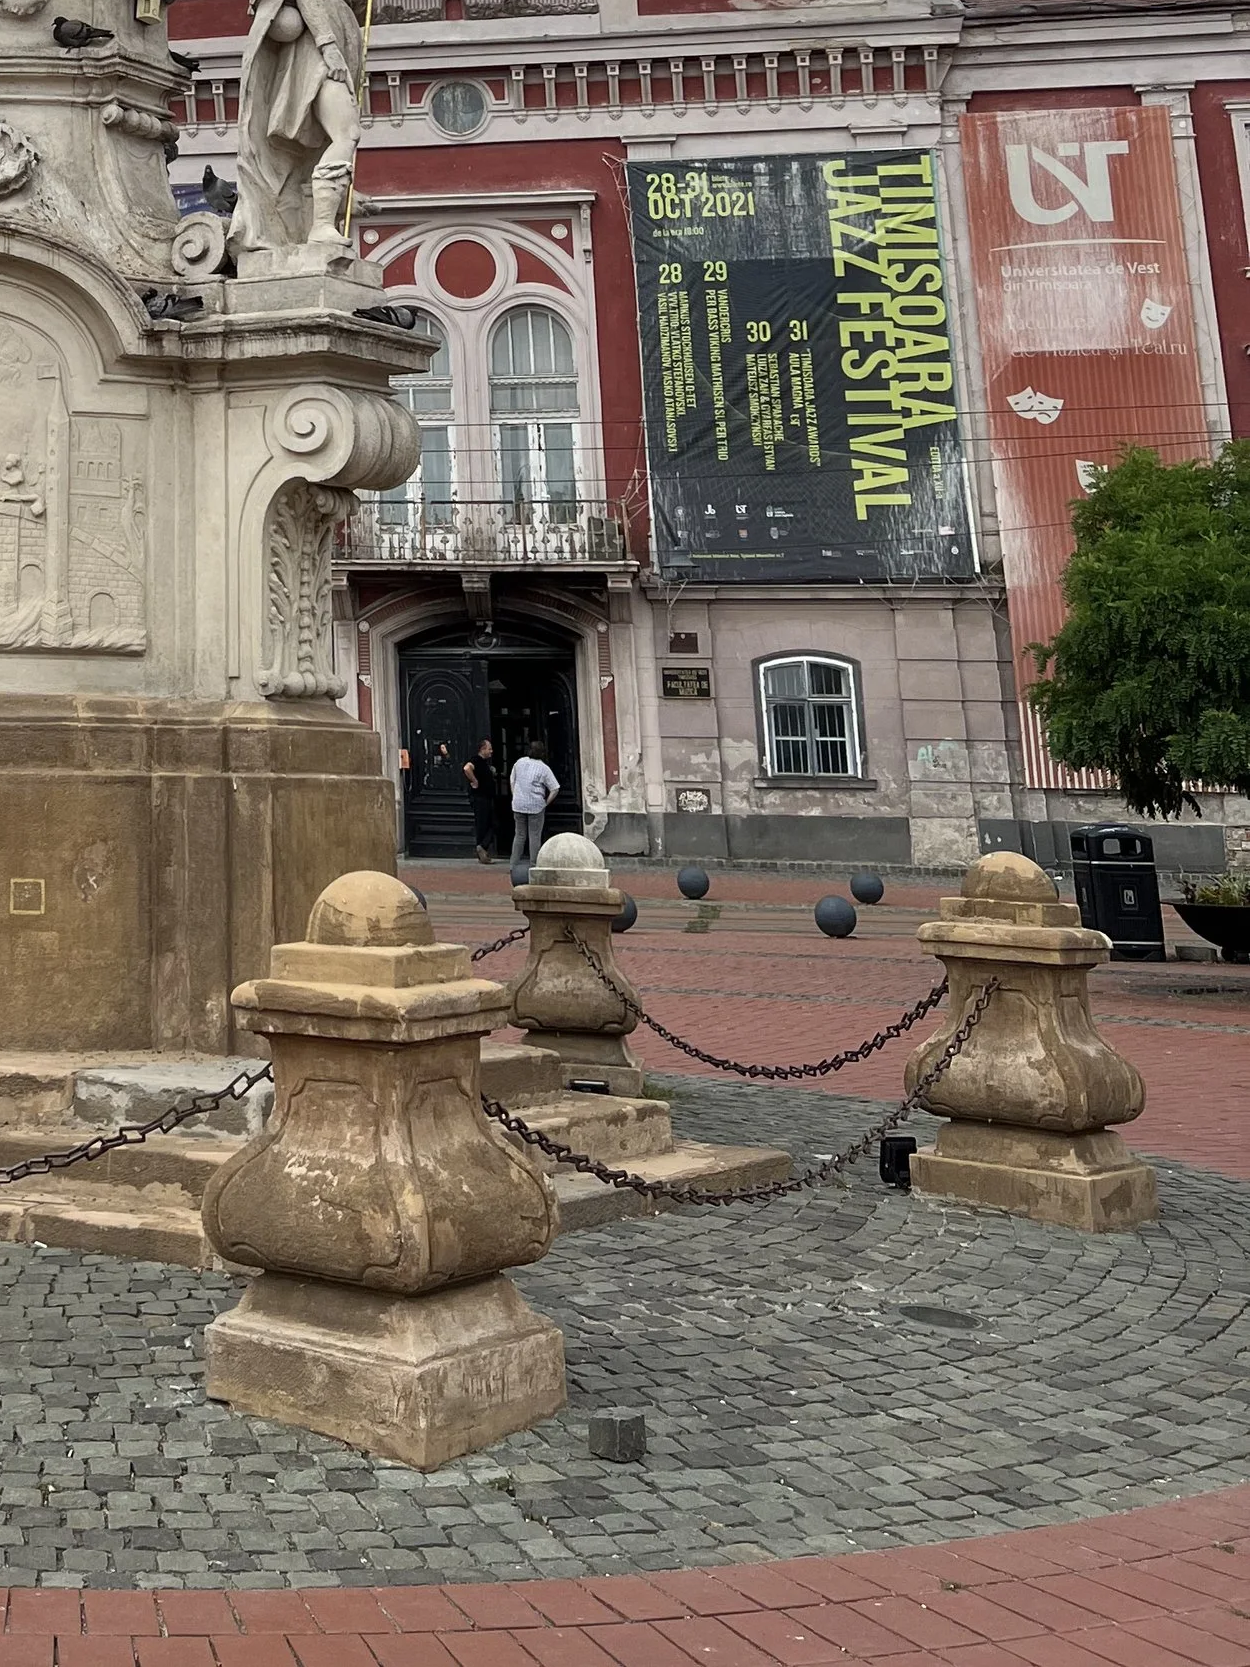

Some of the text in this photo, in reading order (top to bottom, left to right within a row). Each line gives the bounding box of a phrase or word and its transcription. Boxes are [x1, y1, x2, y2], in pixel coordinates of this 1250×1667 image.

[646, 172, 708, 197] 28-31
[648, 191, 755, 219] OCT 2021
[659, 263, 683, 284] 28
[703, 261, 727, 281] 29
[1001, 261, 1161, 278] Universitatea de Vest
[679, 291, 690, 325] MARKUS
[706, 290, 717, 307] PER
[707, 308, 719, 330] BASS
[718, 289, 731, 343] VANDERCRIS
[746, 321, 771, 343] 30
[789, 320, 809, 341] 31
[823, 159, 912, 521] JAZZ FESTIVAL
[657, 293, 667, 315] VASIL
[663, 371, 673, 396] VASKO
[671, 331, 682, 361] VLATKO
[681, 326, 694, 384] STOCKHAUSEN
[709, 332, 721, 361] VIKING
[1132, 338, 1188, 355] Teatru
[746, 354, 758, 391] MATEUSZ
[757, 354, 768, 377] LUIZA
[768, 353, 780, 397] SEBASTIAN
[789, 352, 800, 375] AULA
[711, 363, 724, 408] MATHISEN
[759, 378, 769, 394] ZAN
[791, 377, 803, 409] MAGNA
[760, 395, 769, 403] &
[805, 402, 817, 424] JAZZ
[717, 440, 728, 461] TRIO
[764, 441, 775, 471] ISTVAN
